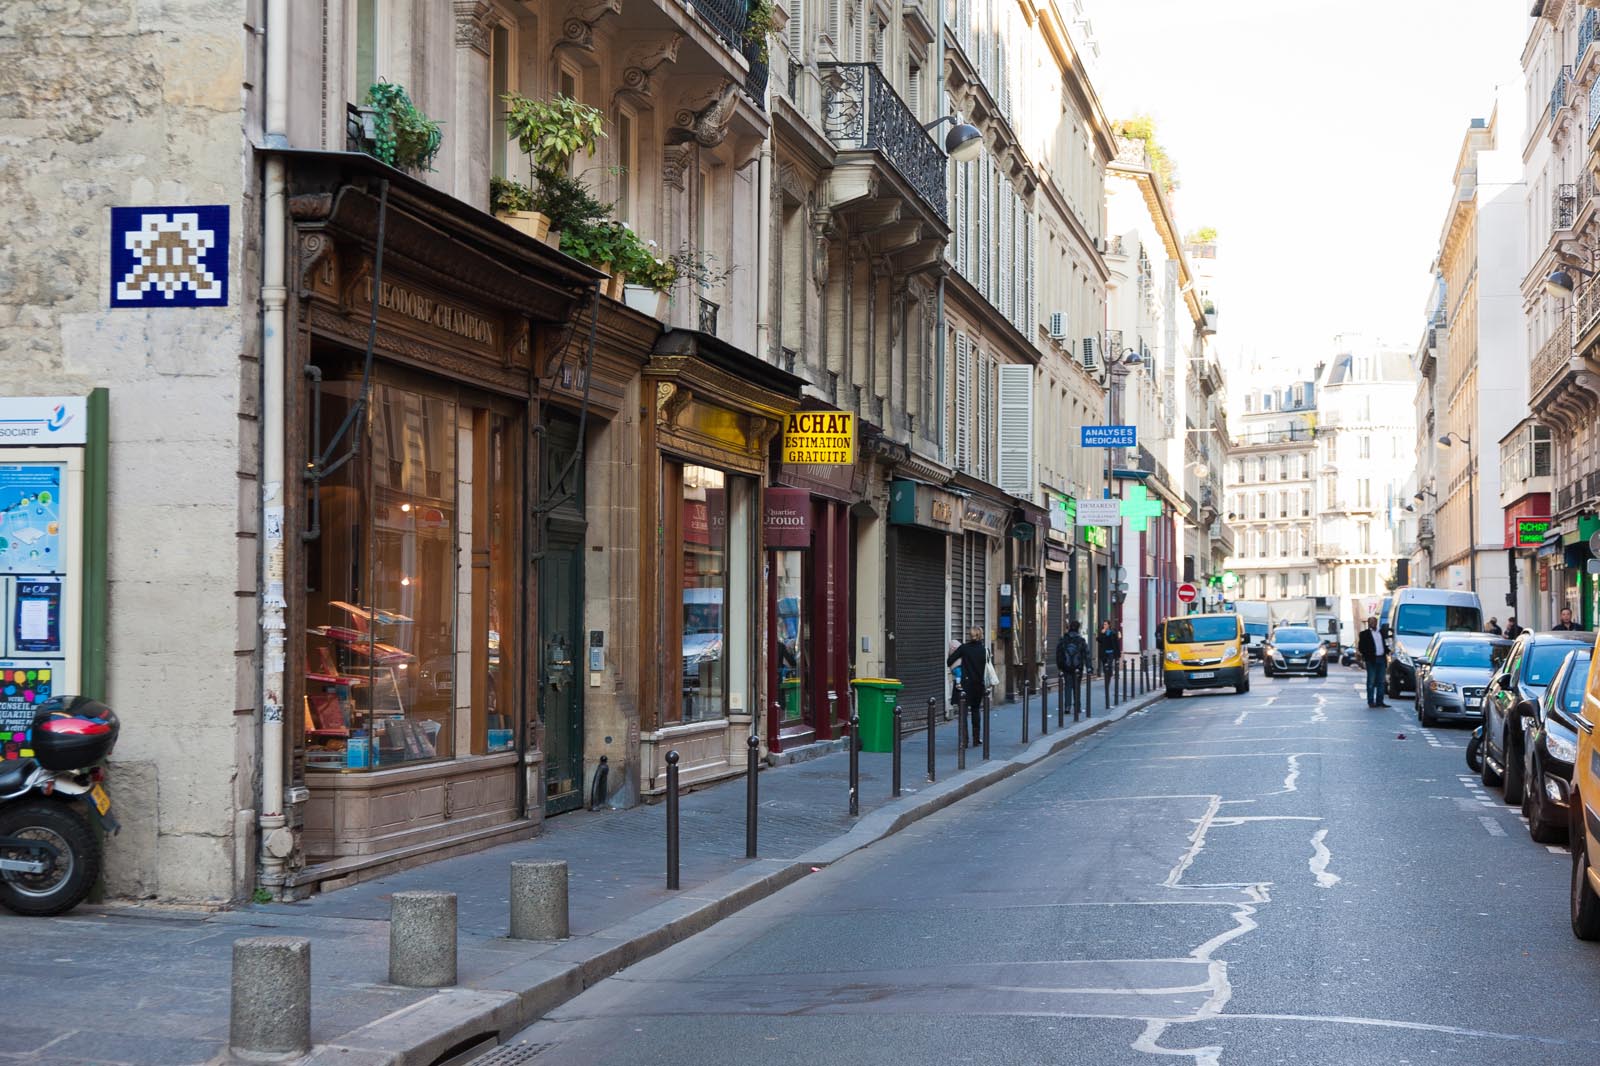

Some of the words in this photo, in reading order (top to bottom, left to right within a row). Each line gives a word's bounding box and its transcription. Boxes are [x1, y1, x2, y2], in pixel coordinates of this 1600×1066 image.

[434, 303, 493, 345] CHAMPION
[786, 414, 851, 434] ACHAT
[1085, 428, 1133, 436] ANALYSES
[785, 436, 851, 449] ESTIMATION
[1085, 437, 1133, 445] MEDICALES
[788, 450, 847, 463] GRATUITE
[768, 508, 797, 517] Quartier
[1519, 521, 1549, 532] ACHAT
[22, 585, 32, 593] Le
[32, 585, 50, 593] CAP
